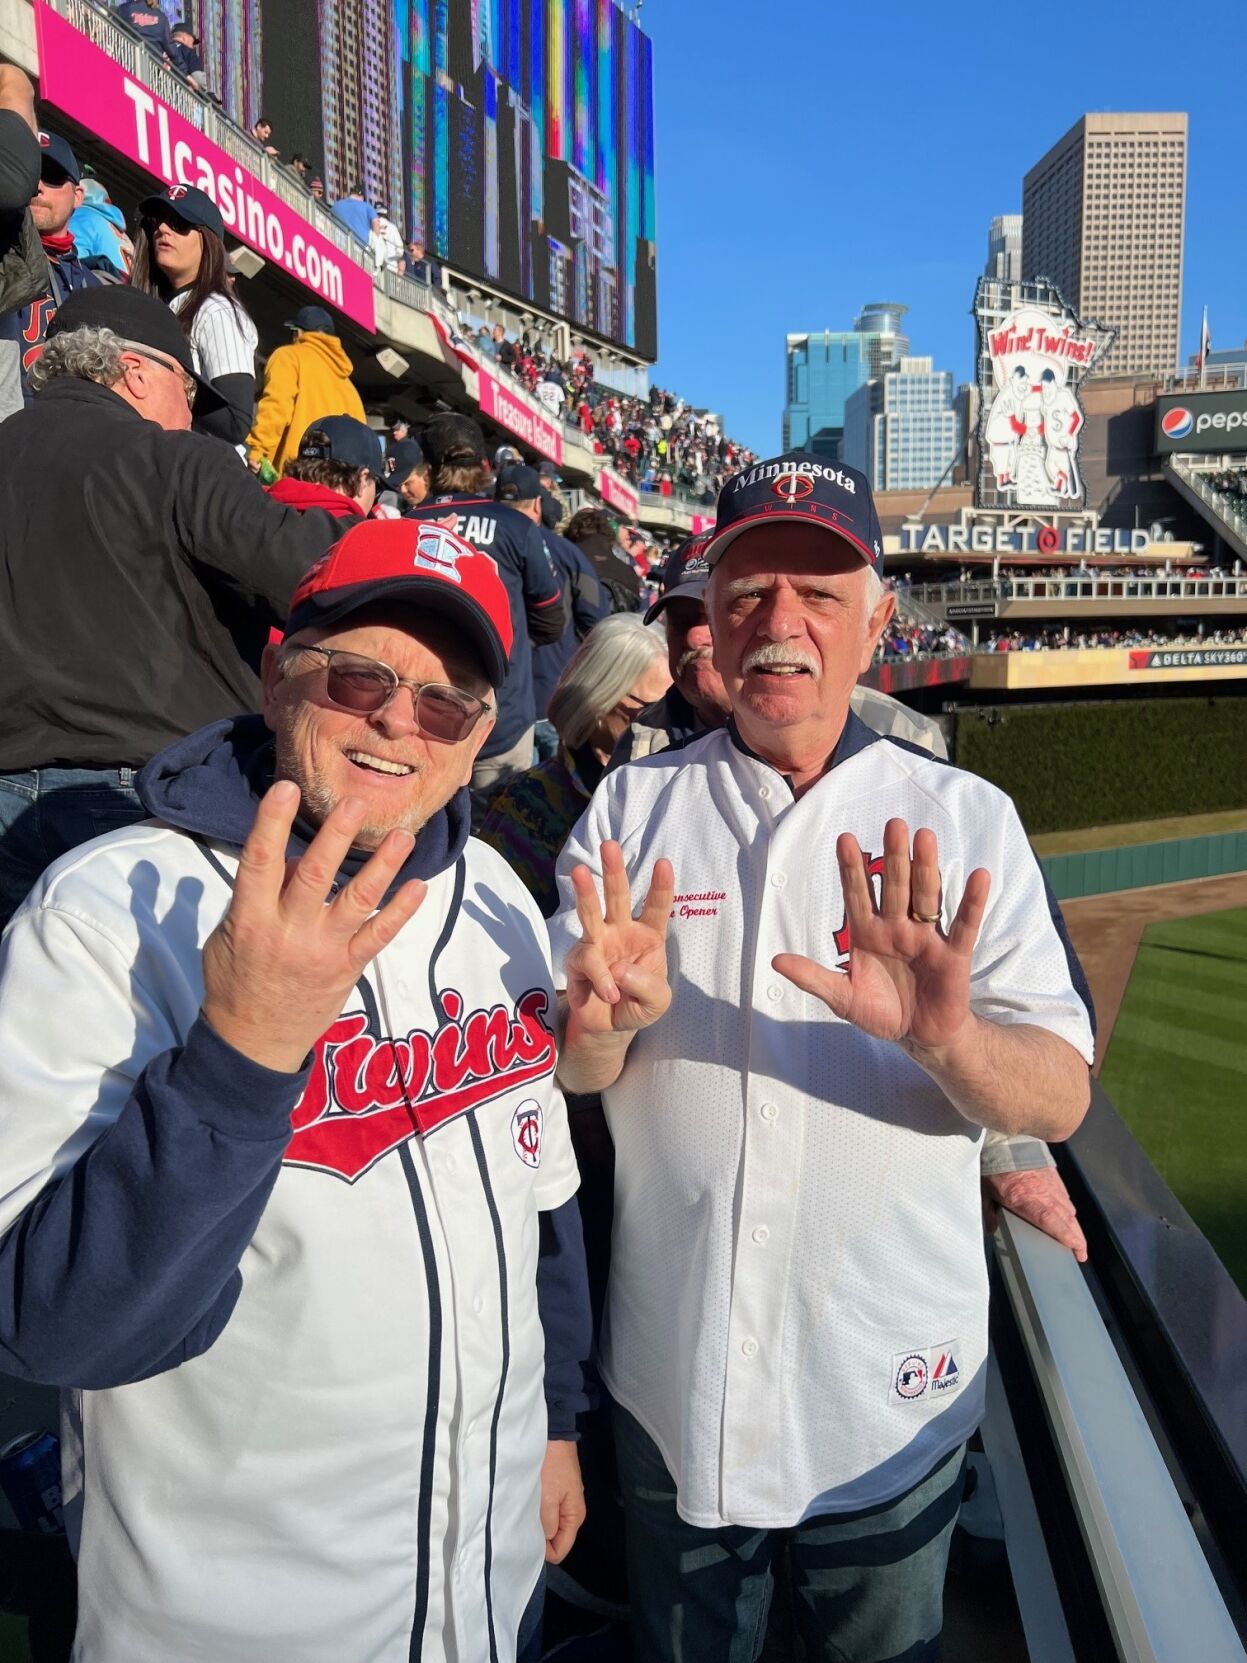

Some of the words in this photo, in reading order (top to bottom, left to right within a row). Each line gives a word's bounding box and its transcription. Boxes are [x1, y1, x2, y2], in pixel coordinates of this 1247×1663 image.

[733, 461, 856, 494] Minnesota
[764, 503, 838, 521] WINS
[902, 524, 1036, 553] TARGET
[1066, 528, 1151, 554] FIELD
[1163, 652, 1203, 666] DELTA
[680, 904, 718, 919] Opener
[289, 987, 558, 1132] Twins
